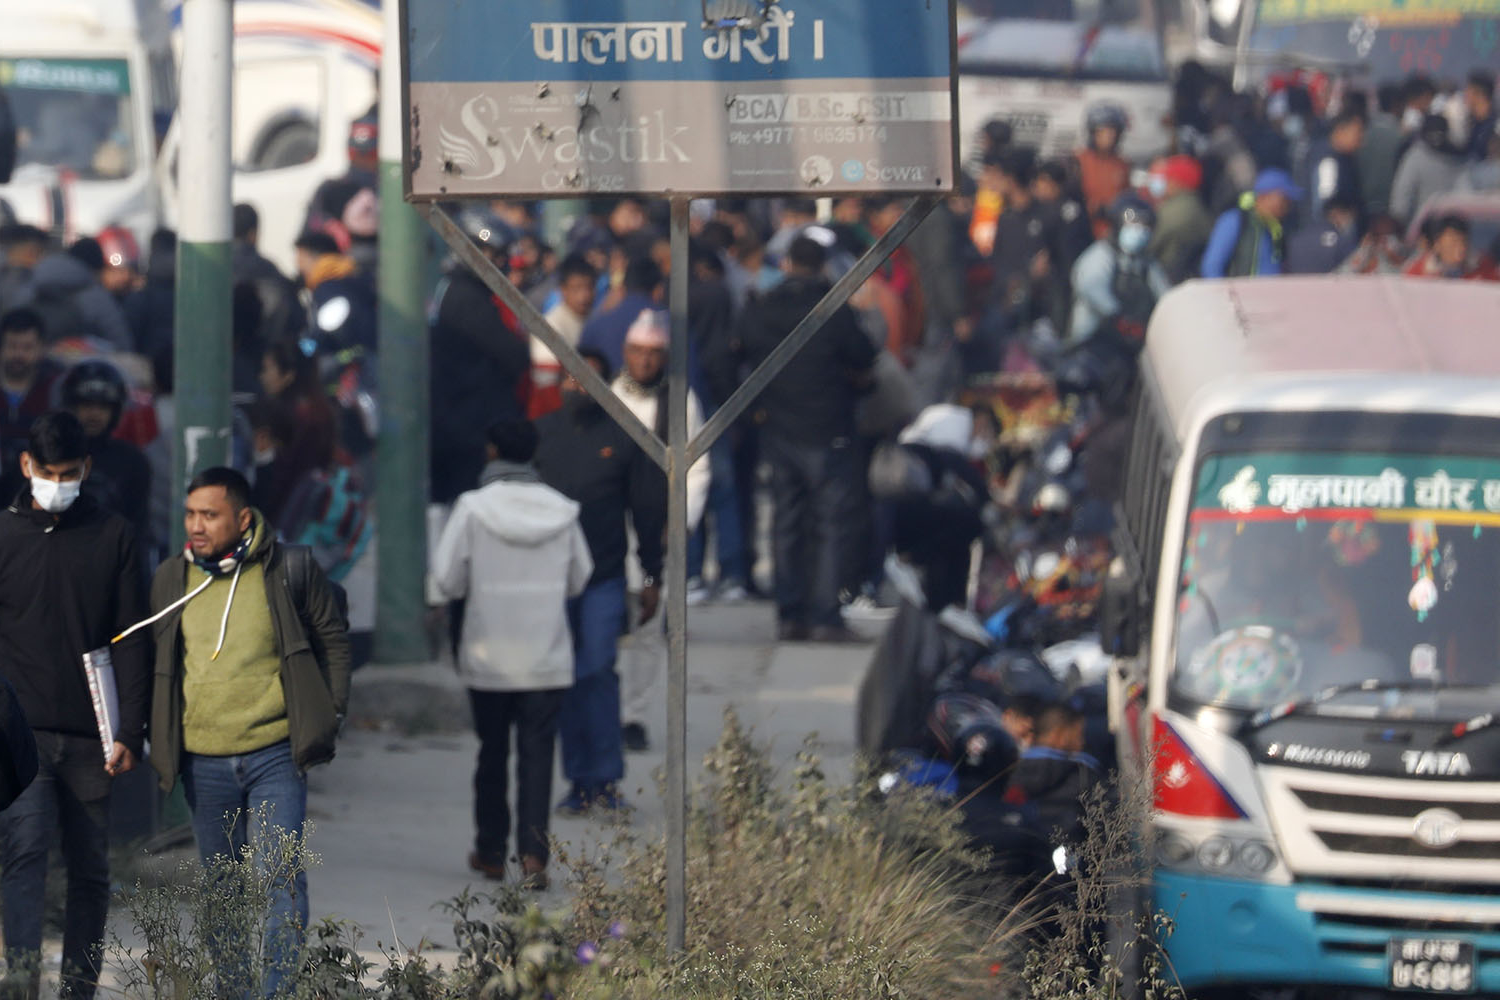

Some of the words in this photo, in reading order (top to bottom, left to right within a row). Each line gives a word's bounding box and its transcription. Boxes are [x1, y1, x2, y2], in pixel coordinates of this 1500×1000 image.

[530, 21, 687, 65] पालना
[736, 96, 789, 120] BCA/
[461, 93, 693, 180] Swastik
[1401, 750, 1471, 776] TATA
